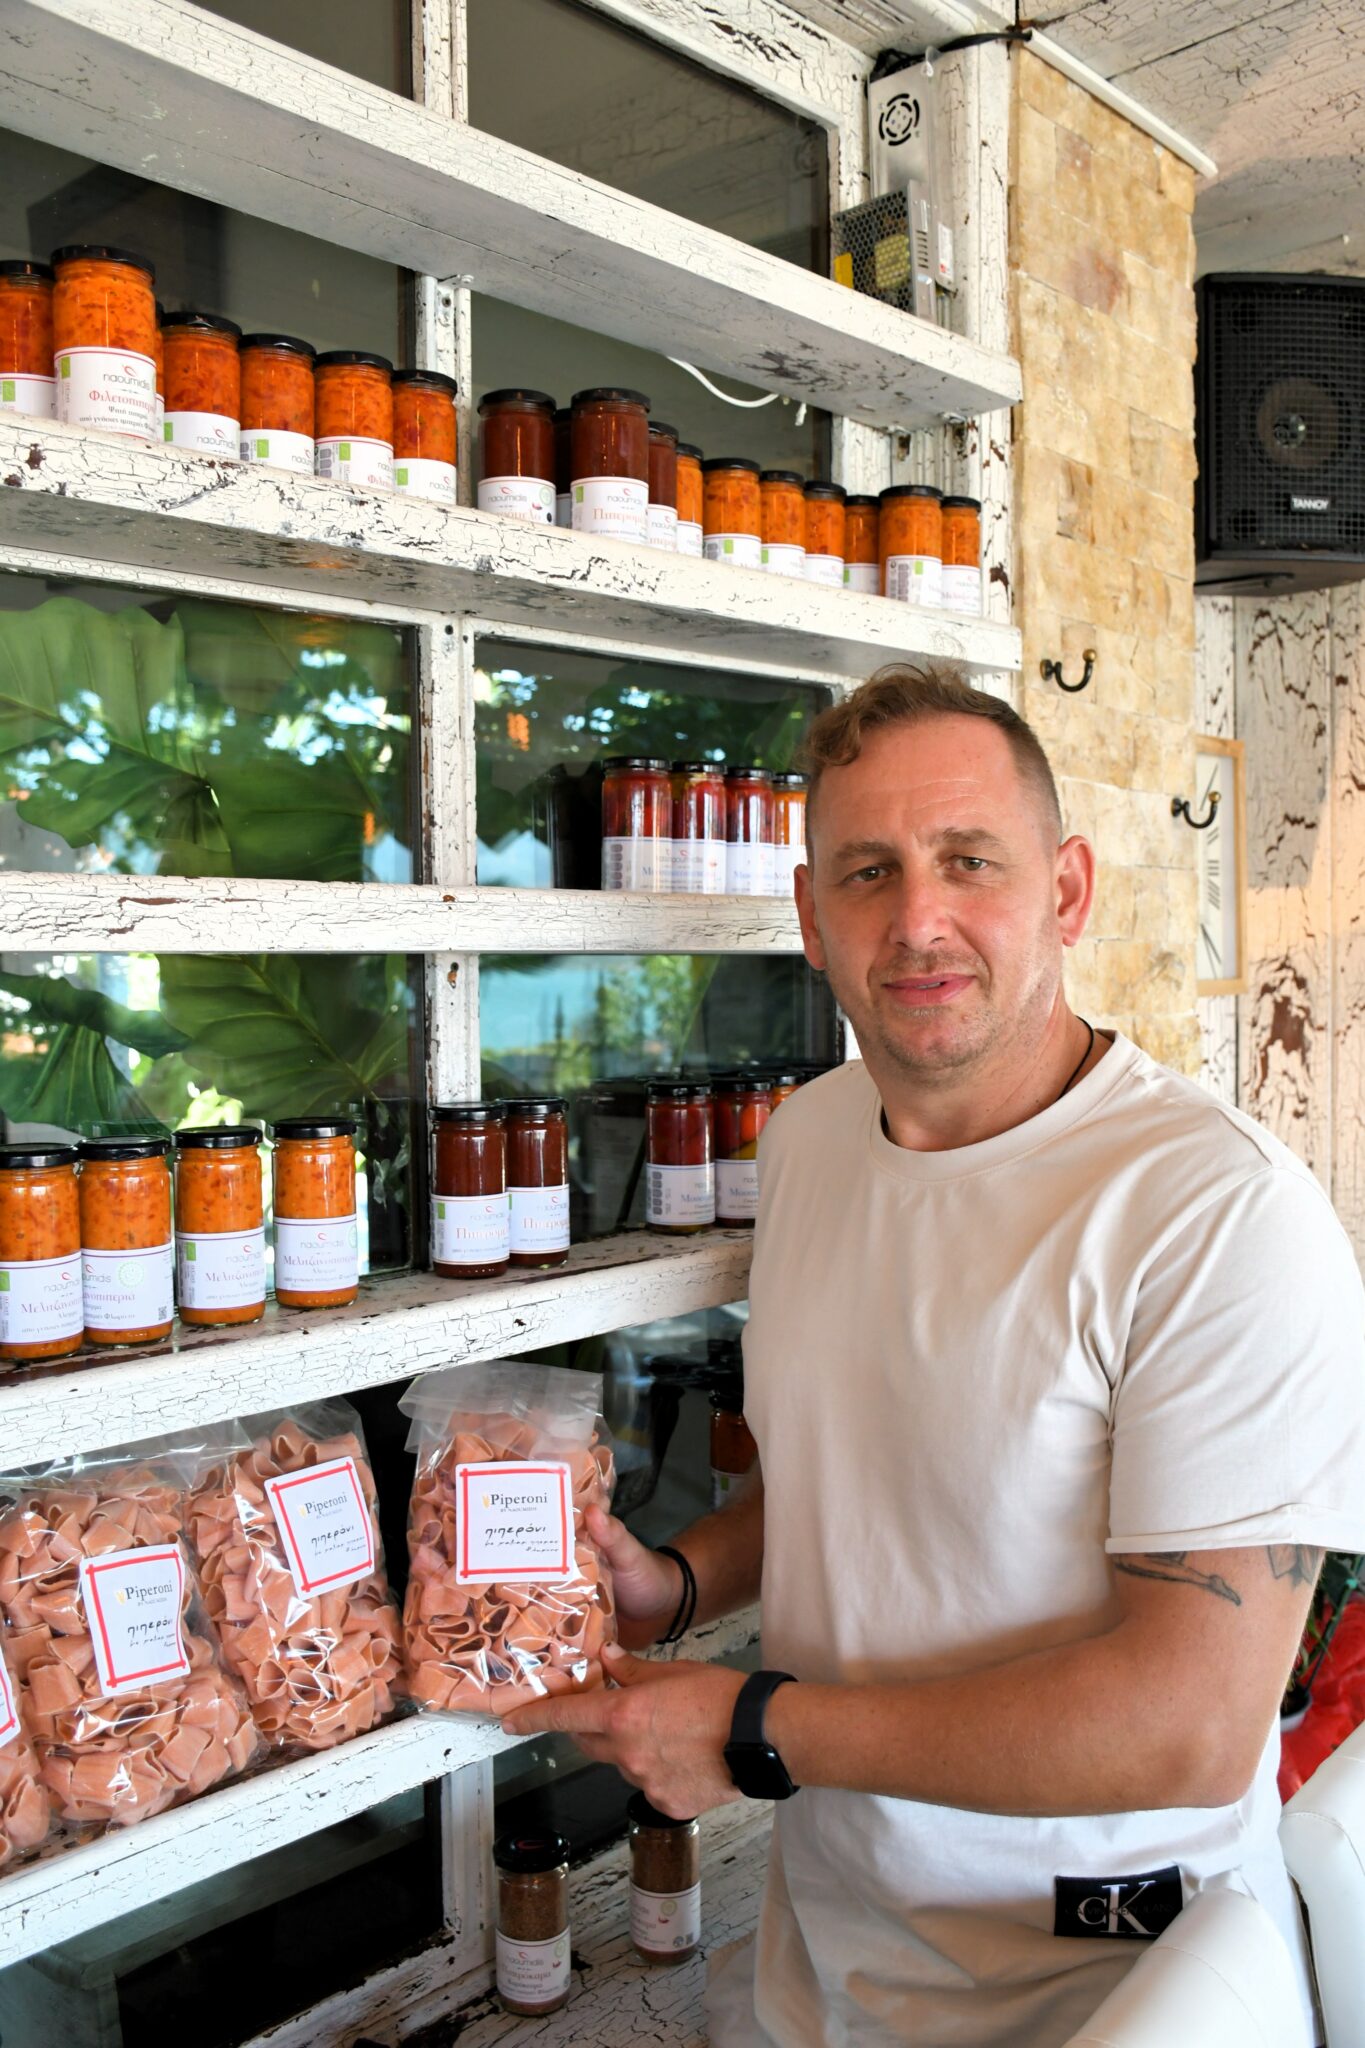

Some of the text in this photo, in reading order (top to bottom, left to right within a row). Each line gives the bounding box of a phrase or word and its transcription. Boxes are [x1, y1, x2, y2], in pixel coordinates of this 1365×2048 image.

[304, 1491, 348, 1515] Piperoni
[490, 1492, 548, 1508] Piperoni
[125, 1580, 173, 1601] Piperoni
